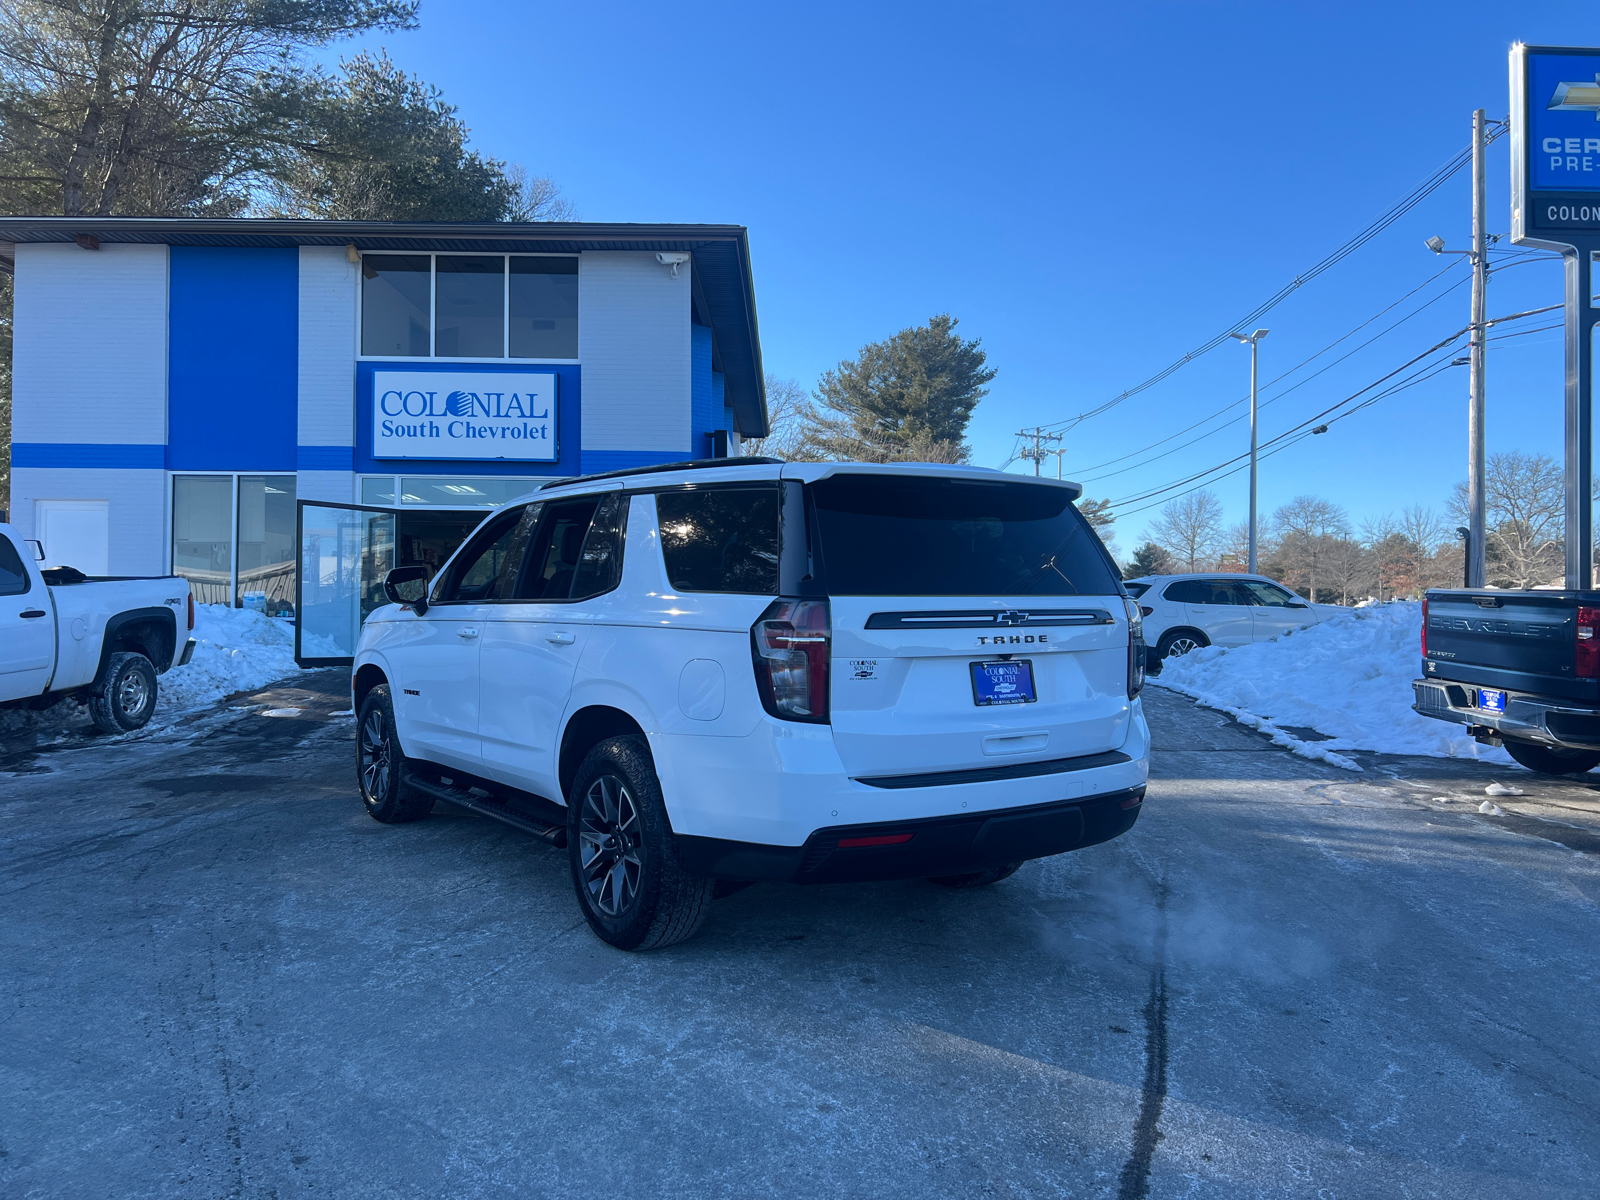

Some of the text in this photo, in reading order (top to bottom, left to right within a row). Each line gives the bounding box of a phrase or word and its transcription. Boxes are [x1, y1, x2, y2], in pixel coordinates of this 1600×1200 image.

[1542, 137, 1600, 154] CER
[1547, 206, 1600, 221] COLON
[381, 390, 549, 418] COLONIAL
[381, 419, 548, 439] South Chevrolet
[1429, 616, 1559, 637] CHEVROLET
[977, 635, 1048, 644] TAHOE
[985, 666, 1020, 676] COLONIAL
[991, 675, 1016, 683] SOUTH
